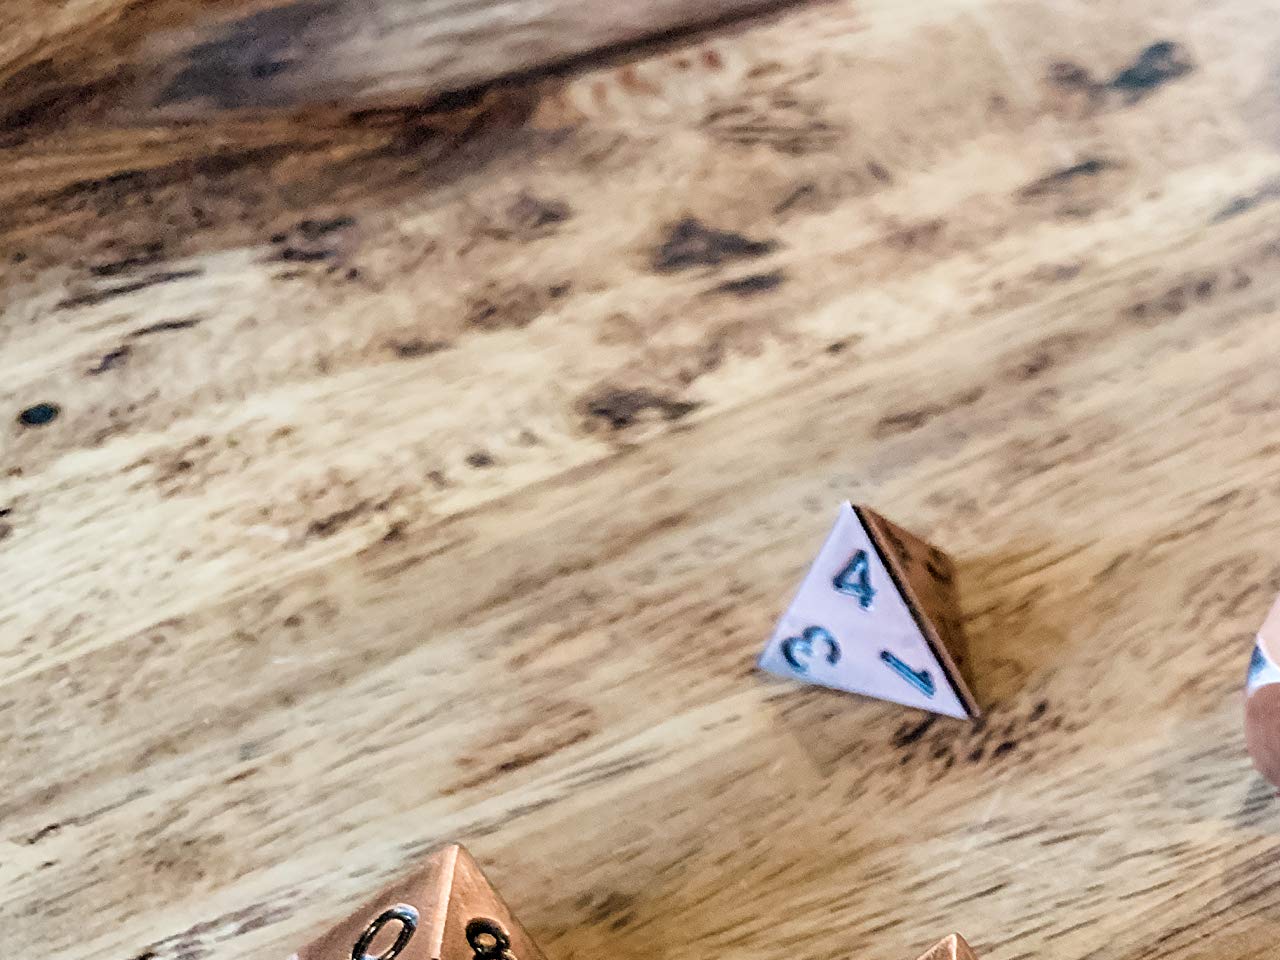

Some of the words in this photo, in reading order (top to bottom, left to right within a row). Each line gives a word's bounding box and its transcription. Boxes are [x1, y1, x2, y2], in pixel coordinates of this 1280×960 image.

[833, 549, 876, 611] 4
[779, 625, 841, 675] 3
[879, 649, 937, 699] 1
